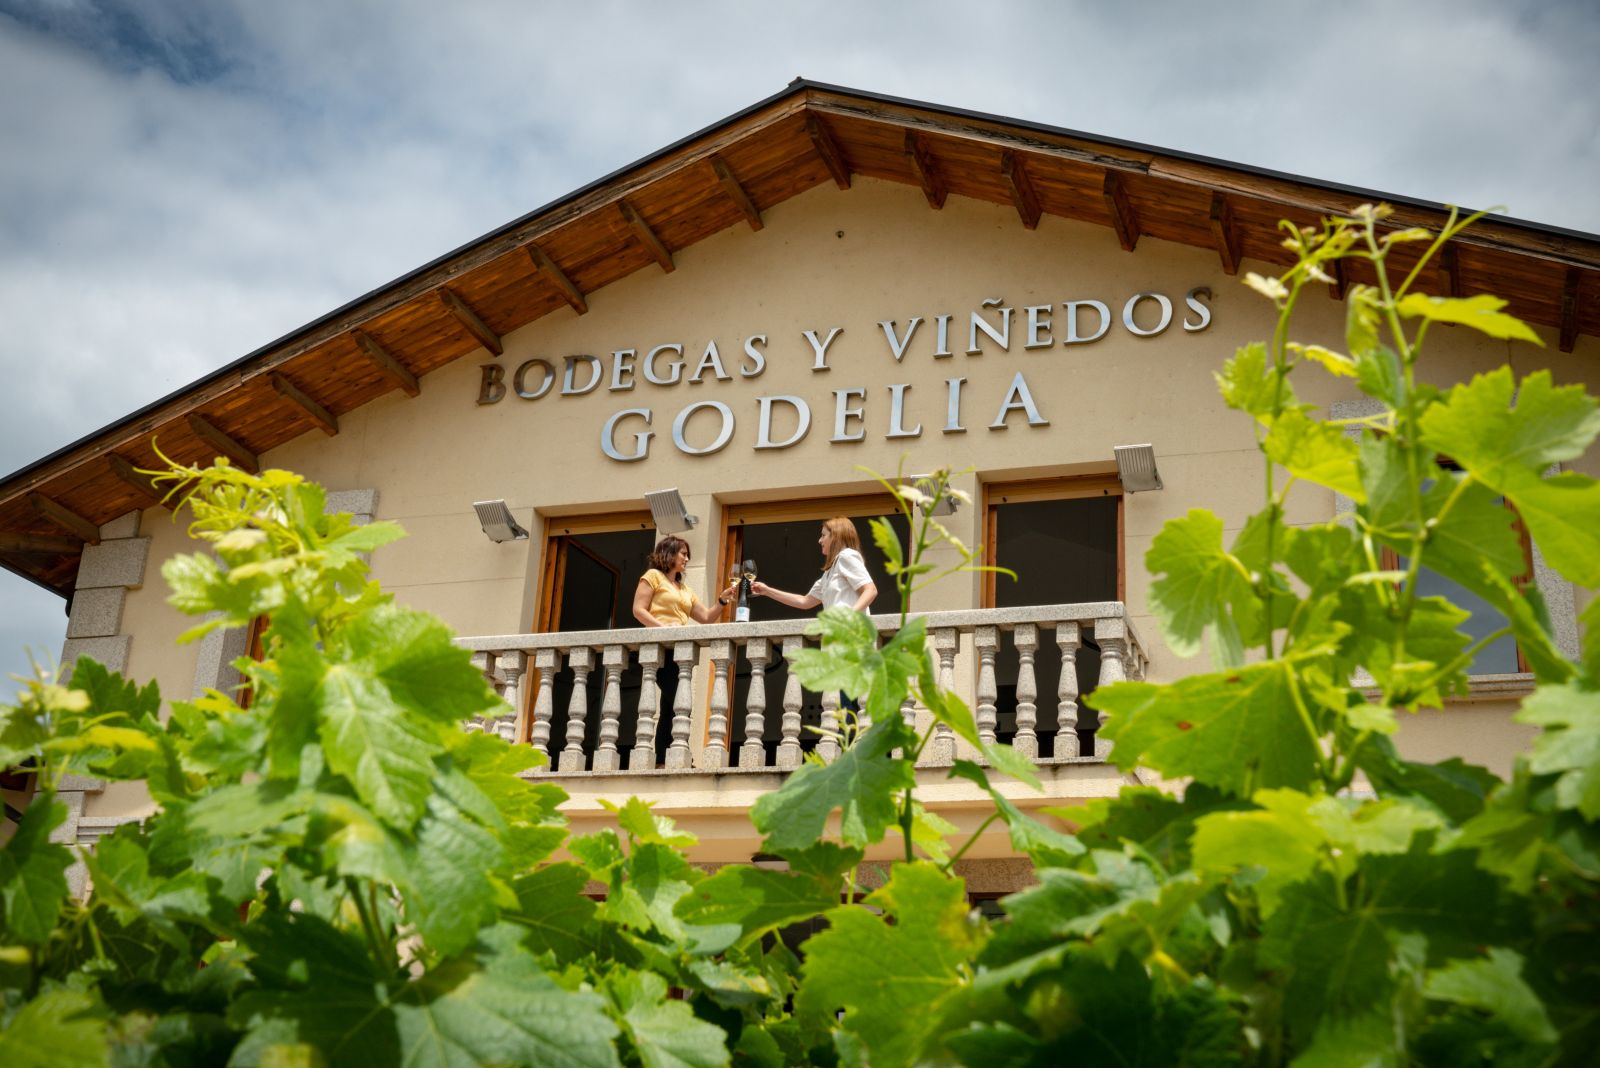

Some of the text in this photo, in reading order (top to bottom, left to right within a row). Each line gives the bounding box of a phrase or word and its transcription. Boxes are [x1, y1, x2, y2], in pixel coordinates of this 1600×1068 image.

[476, 286, 1212, 406] BODEGAS Y VIÑEDOS
[600, 371, 1050, 463] GODELIA
